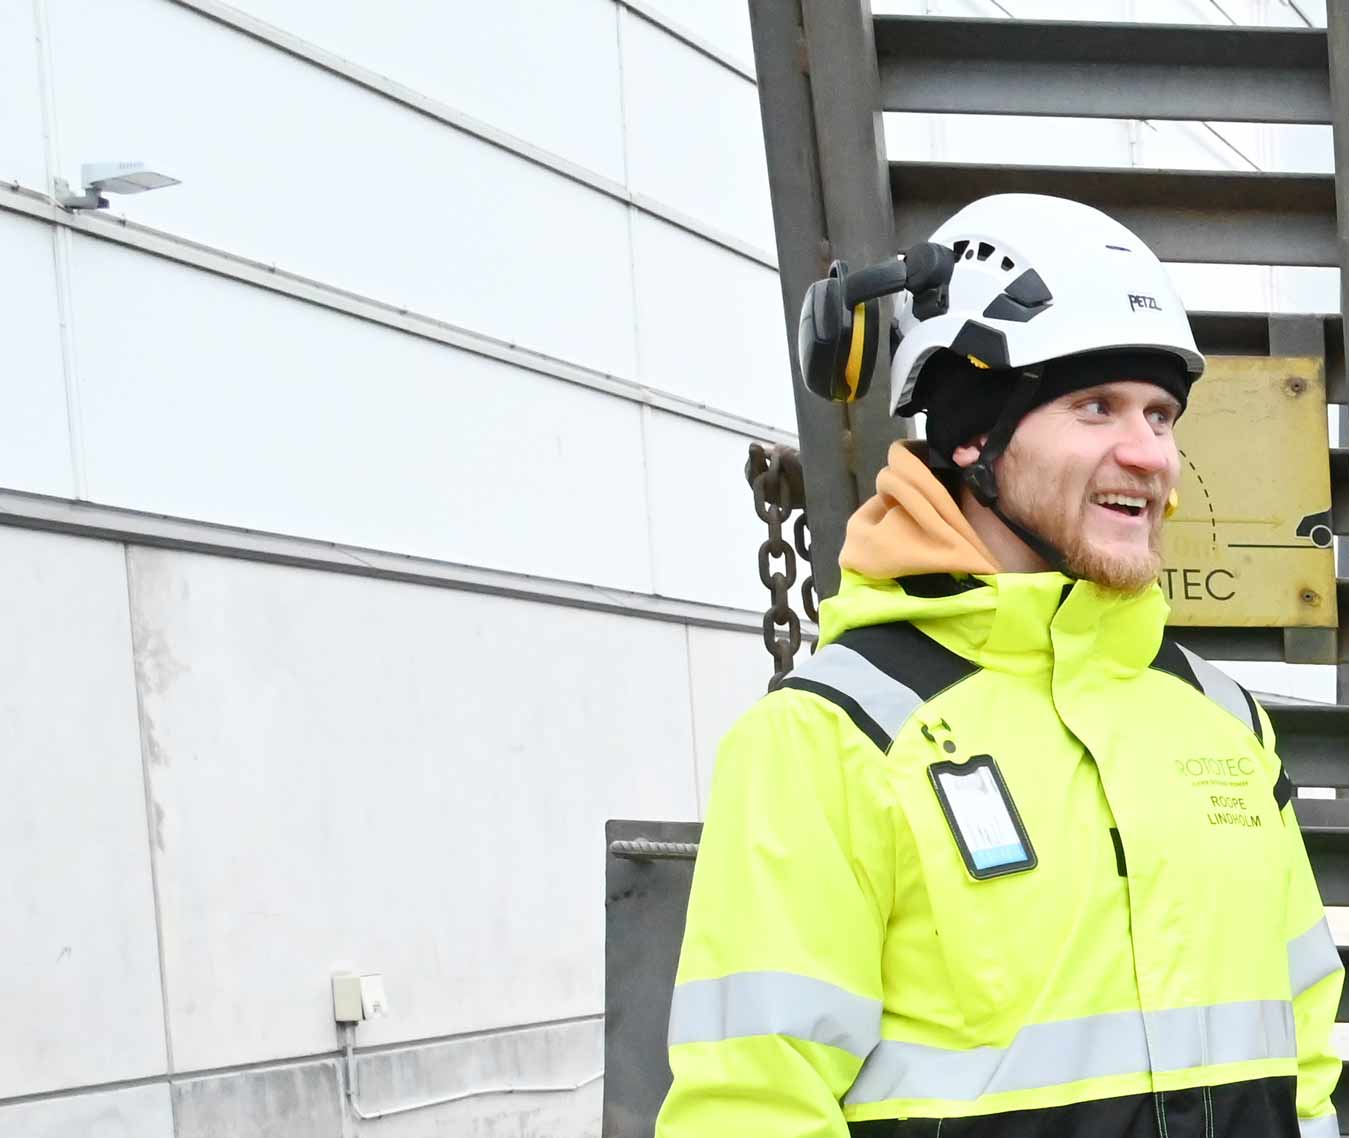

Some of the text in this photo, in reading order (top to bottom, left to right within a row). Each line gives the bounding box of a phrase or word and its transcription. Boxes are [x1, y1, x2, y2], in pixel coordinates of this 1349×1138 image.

[1128, 294, 1163, 313] PETZL
[1210, 795, 1247, 810] ROOPE
[1207, 813, 1262, 828] LINDHOLM
